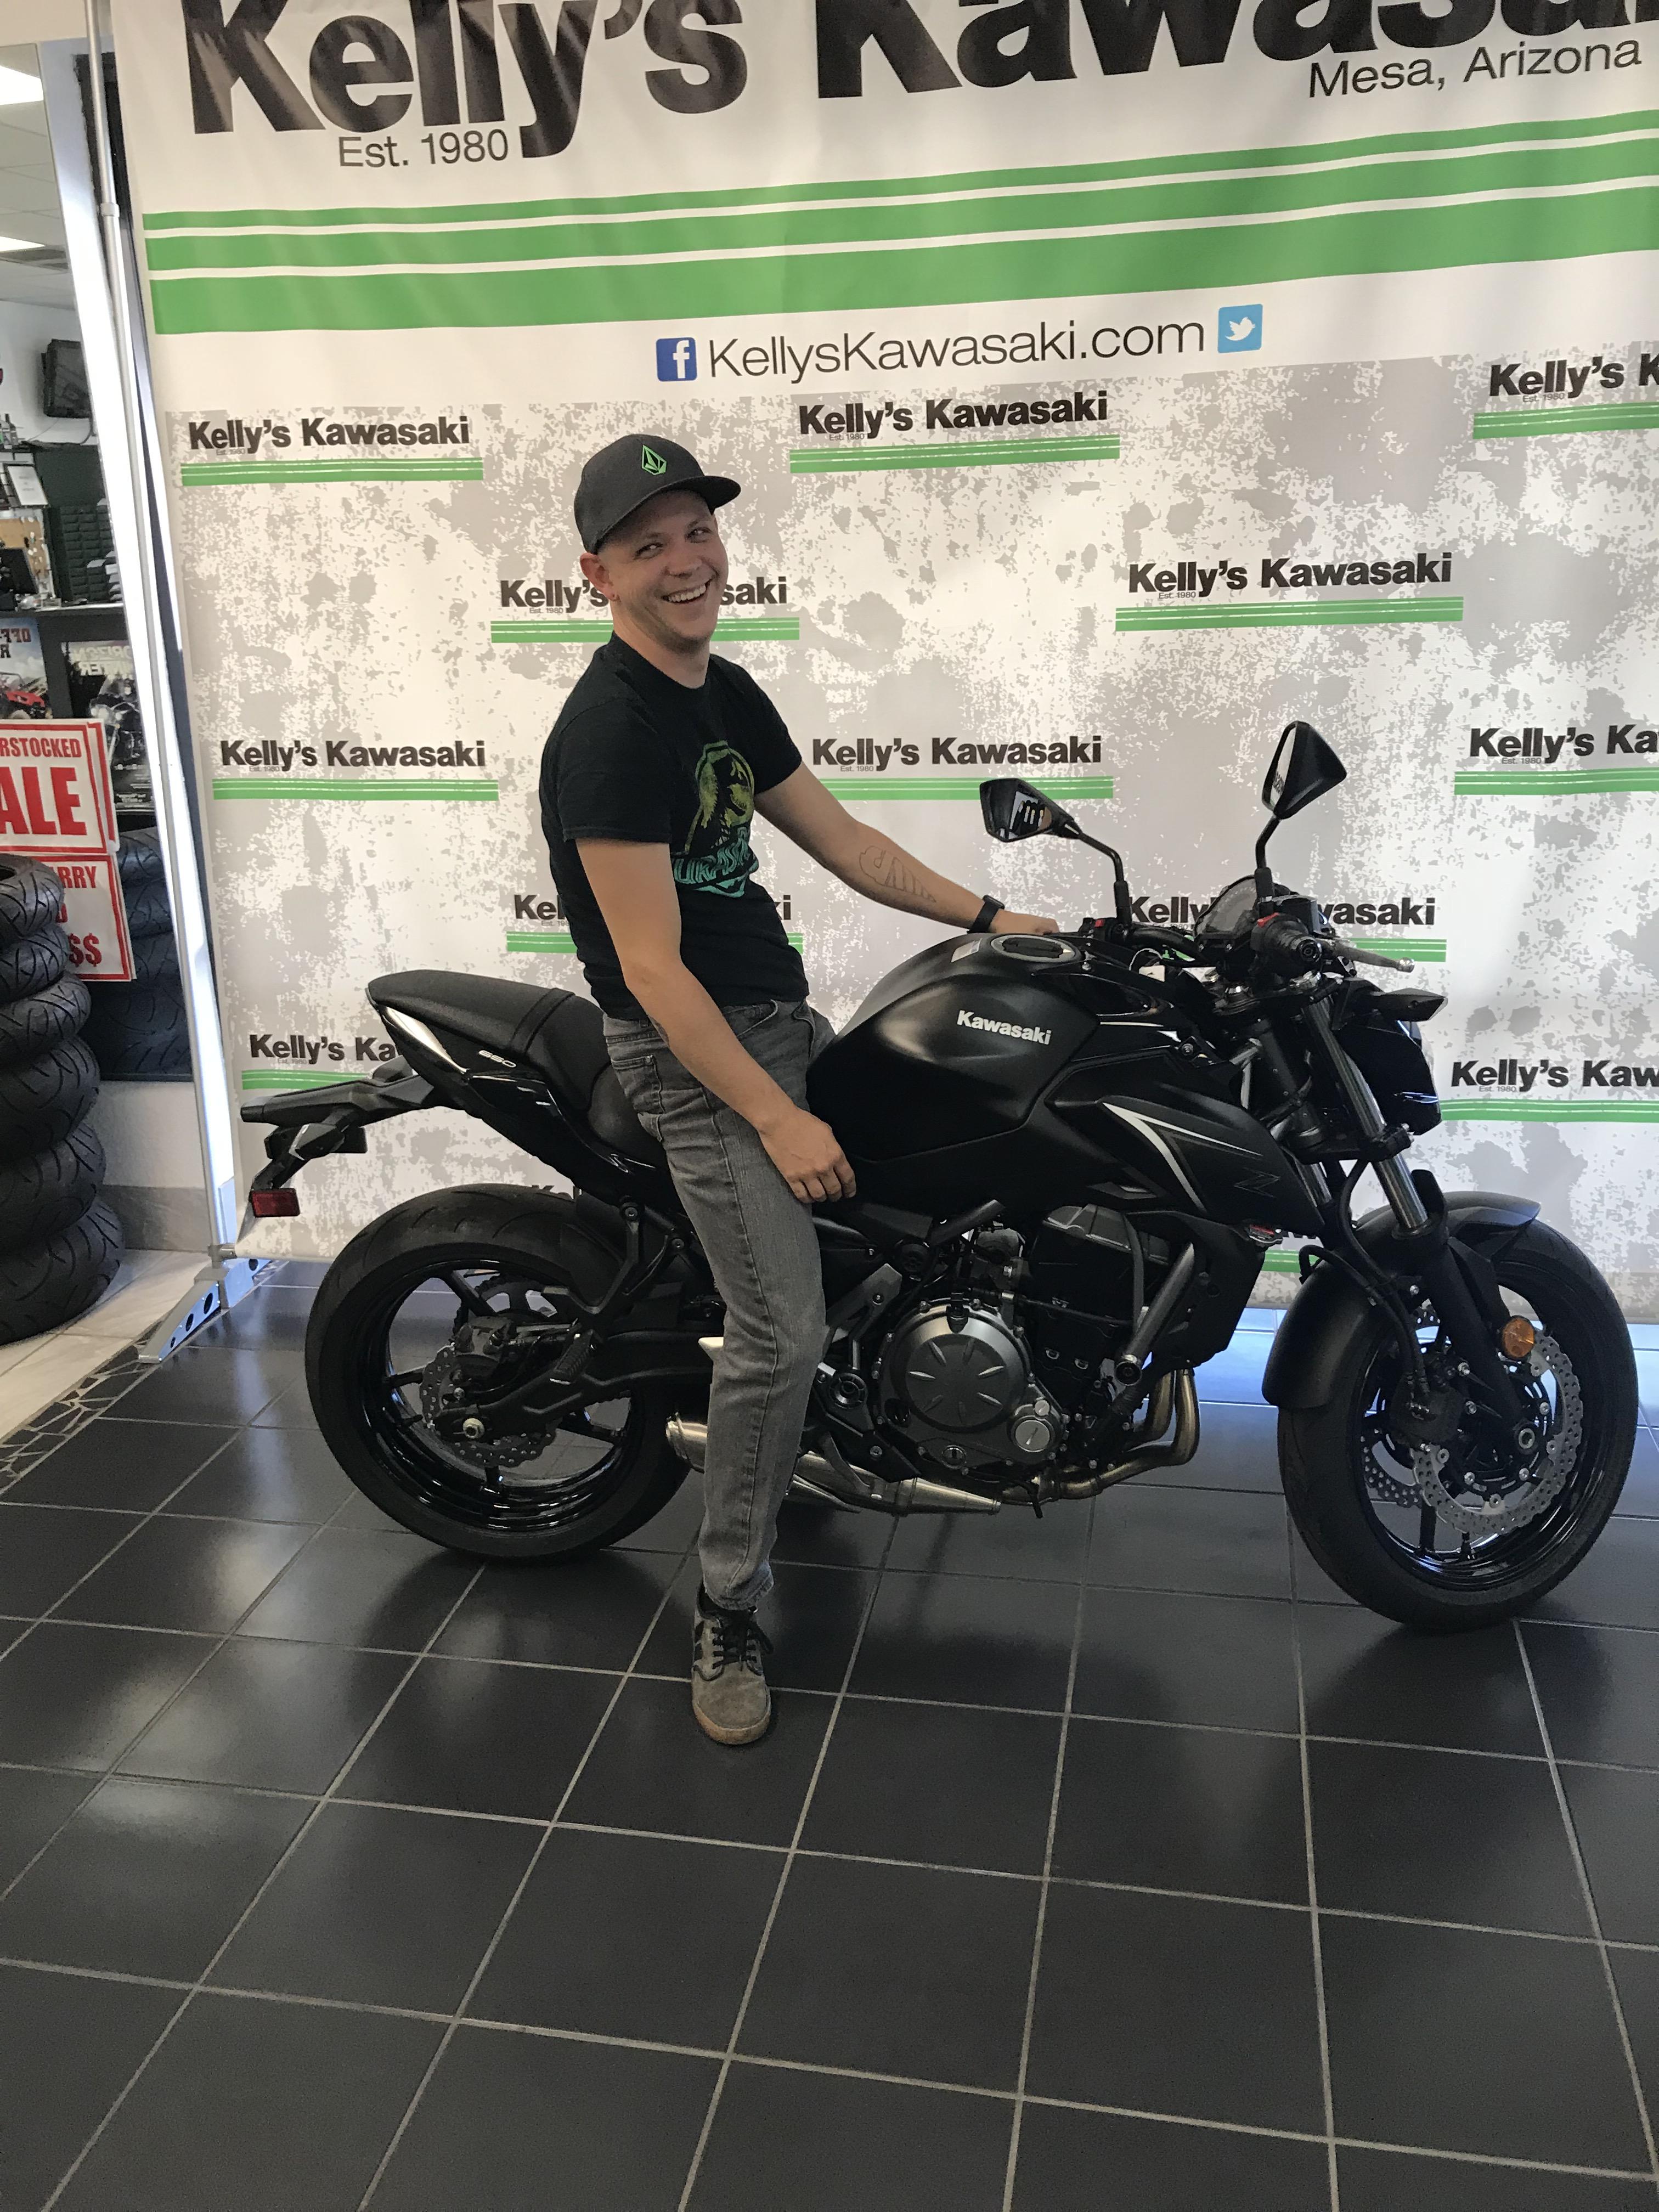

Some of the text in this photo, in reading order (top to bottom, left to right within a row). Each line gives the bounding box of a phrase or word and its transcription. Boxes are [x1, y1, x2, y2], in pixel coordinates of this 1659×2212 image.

[1308, 39, 1642, 98] Mesa, Arizona
[338, 129, 509, 167] Est. 1980
[709, 320, 1204, 383] KellysKawasaki.com
[1489, 356, 1624, 399] Kelly's
[799, 390, 1107, 439] Kelly's Kawasaki
[189, 416, 469, 454] Kelly's Kawasaki
[1129, 552, 1452, 597] Kelly's Kawasaki
[500, 579, 609, 613] Kelly's
[221, 740, 485, 772] Kelly's Kawasaki
[813, 735, 1101, 771] Kelly's Kawasaki
[1470, 727, 1594, 764] Kelly's
[957, 1010, 1052, 1045] Kawasaki
[250, 1034, 345, 1065] Kelly's
[478, 1049, 517, 1068] 650
[1451, 1059, 1569, 1092] Kelly's
